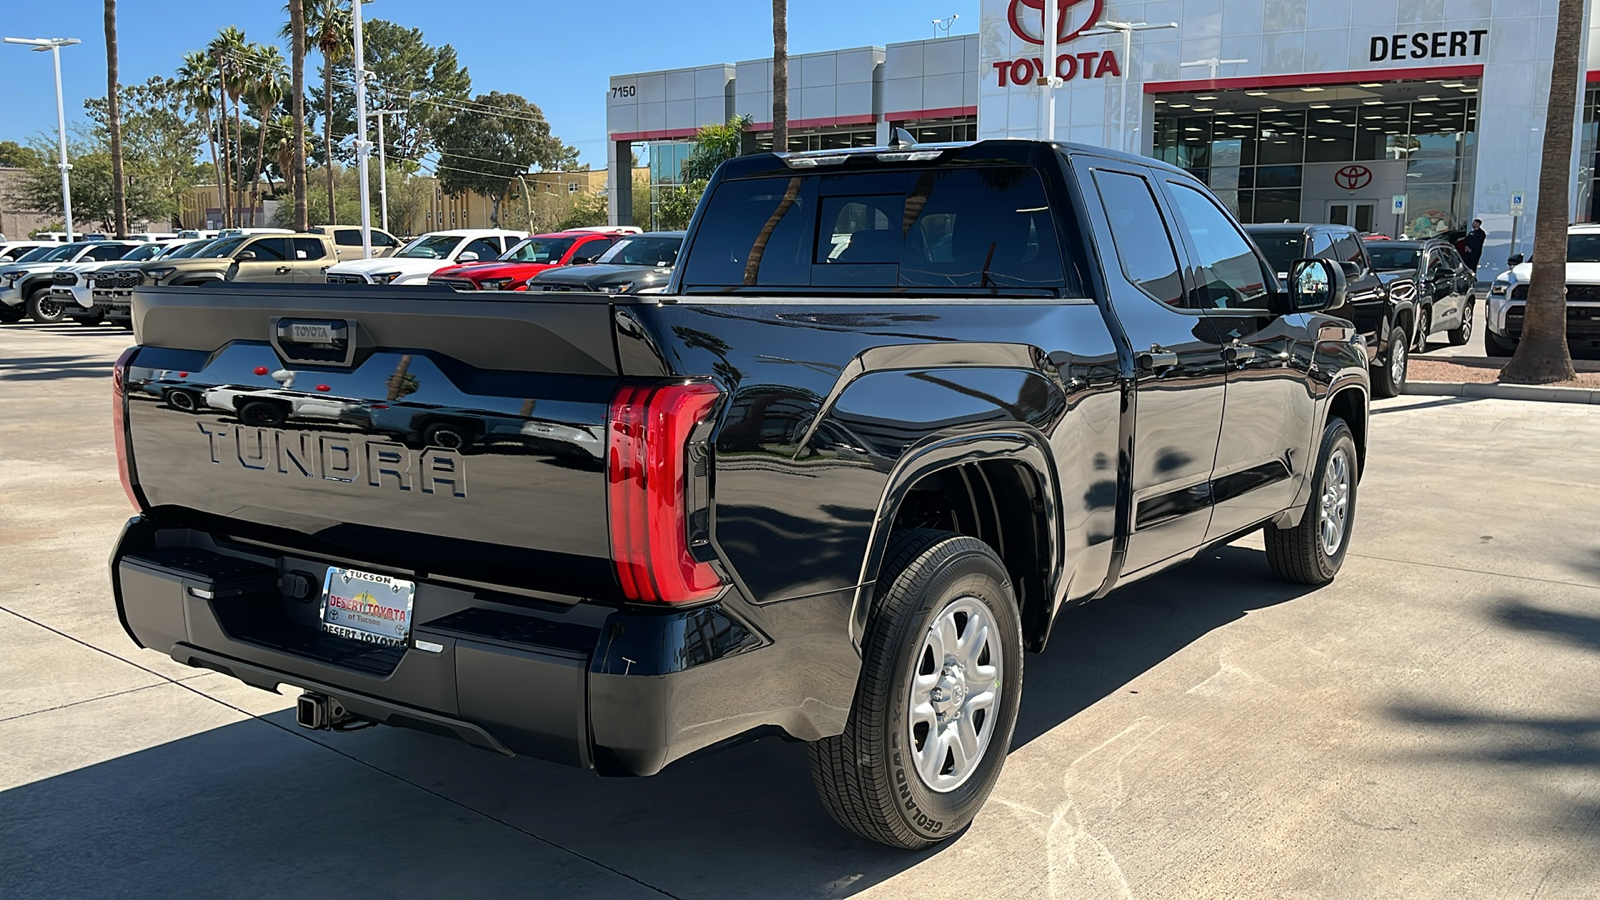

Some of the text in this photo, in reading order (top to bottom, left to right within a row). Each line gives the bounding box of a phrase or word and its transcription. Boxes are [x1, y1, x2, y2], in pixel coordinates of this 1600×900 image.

[1370, 29, 1488, 62] DESERT
[611, 85, 636, 99] 7150
[294, 325, 328, 338] TOYOTA
[196, 421, 466, 498] TUNDRA
[349, 570, 391, 584] TUCSON
[329, 595, 406, 623] DESERT TOYOTA
[347, 613, 381, 627] of Tucson
[322, 624, 401, 649] DESERT TOYOTA
